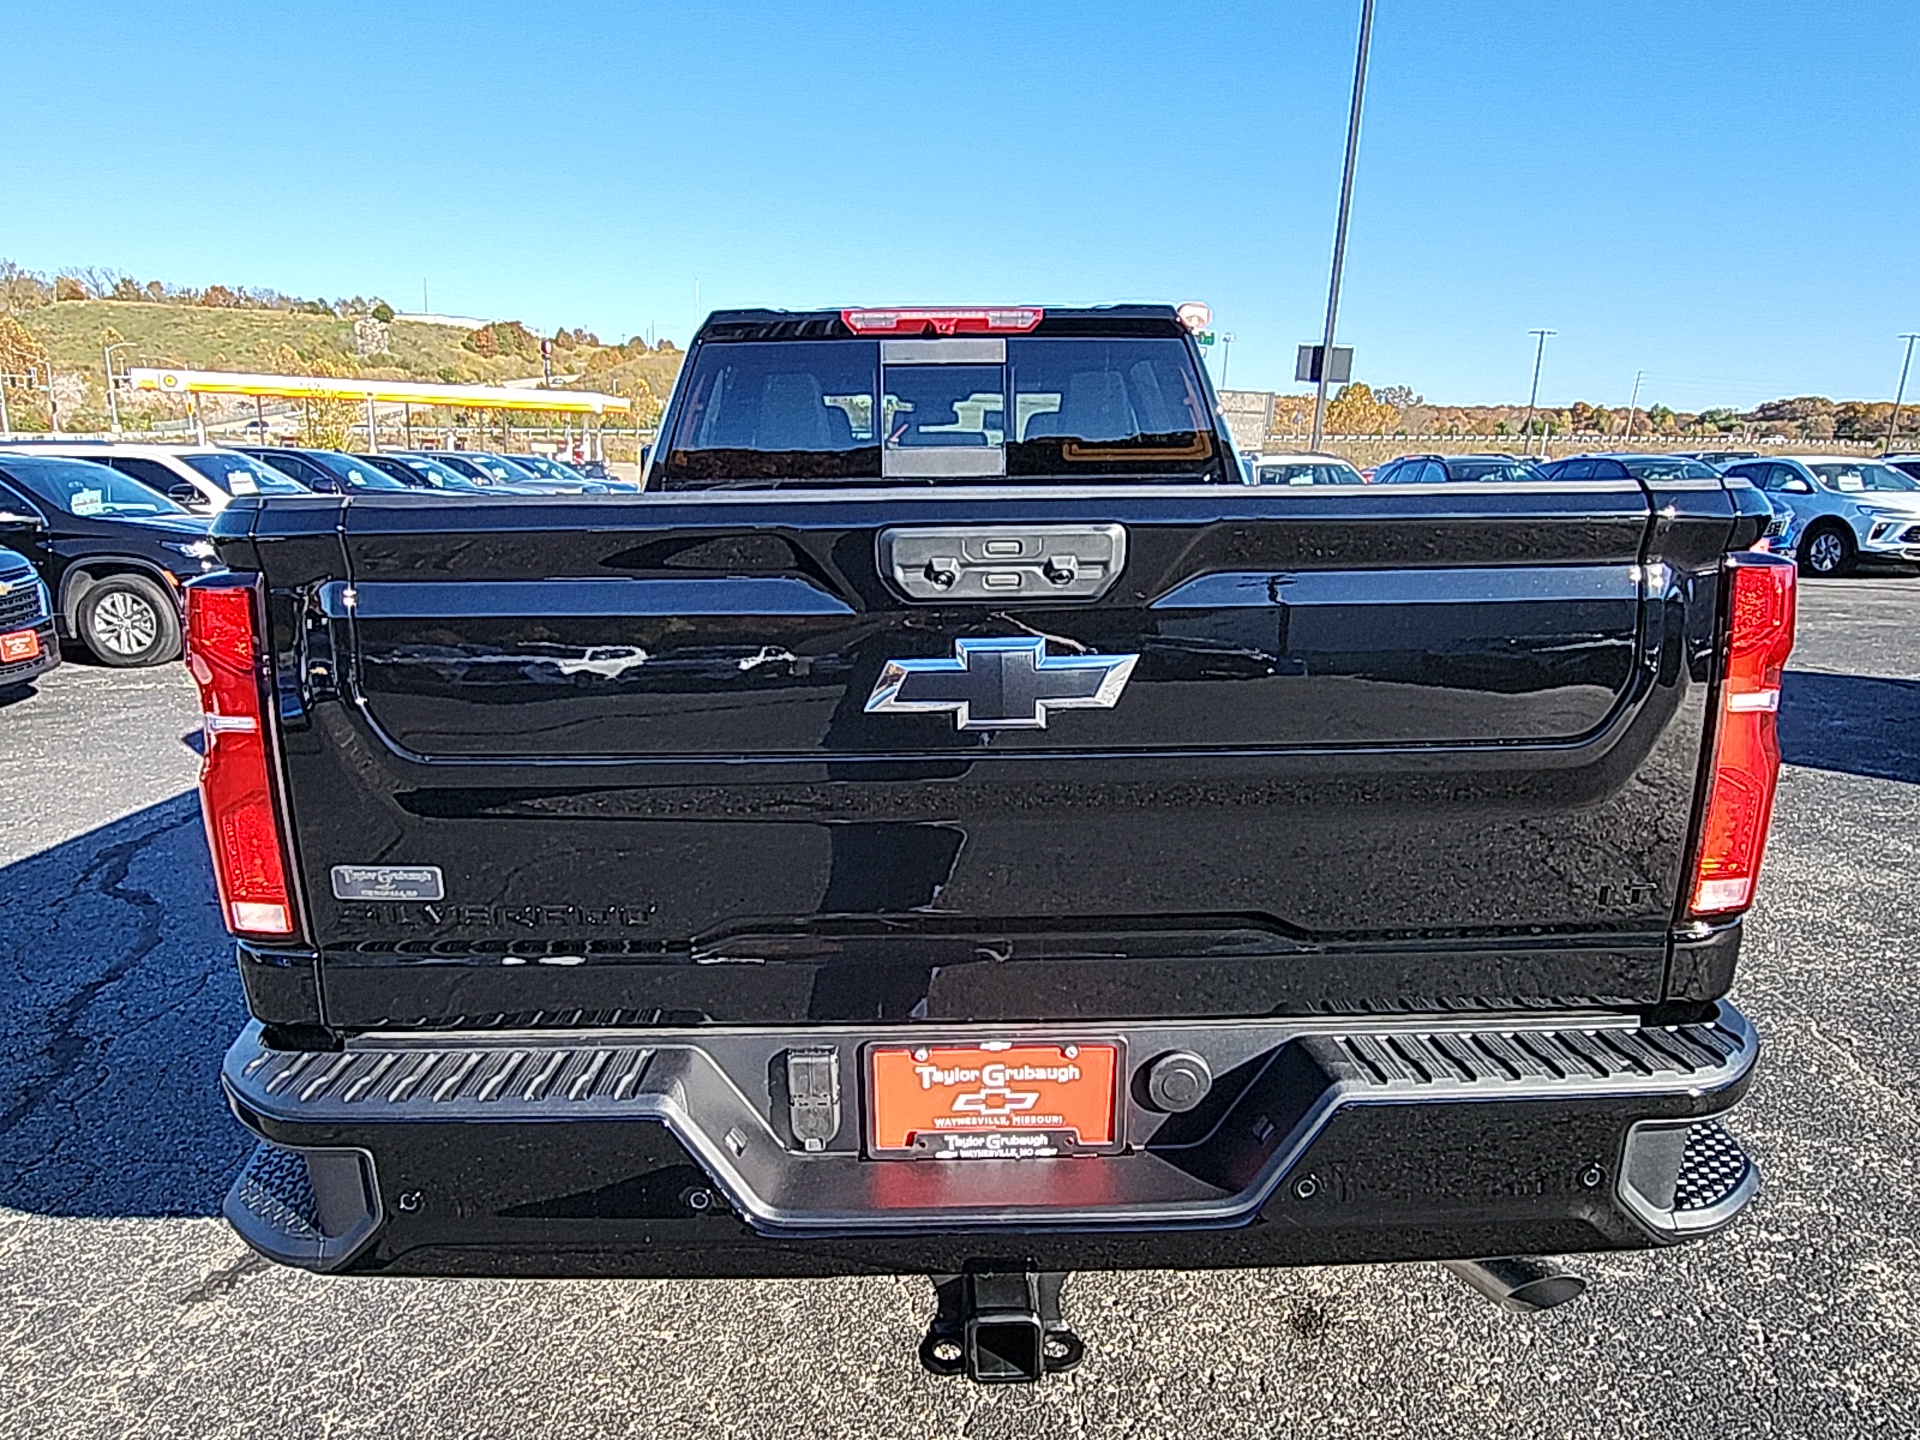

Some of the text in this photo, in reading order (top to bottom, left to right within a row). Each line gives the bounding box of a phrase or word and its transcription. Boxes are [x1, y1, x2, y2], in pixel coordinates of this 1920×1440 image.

[914, 1063, 1081, 1090] Taylor Grubaugh
[1012, 1115, 1064, 1126] MISSOURI
[943, 1133, 1048, 1151] Taylor Grubaugh
